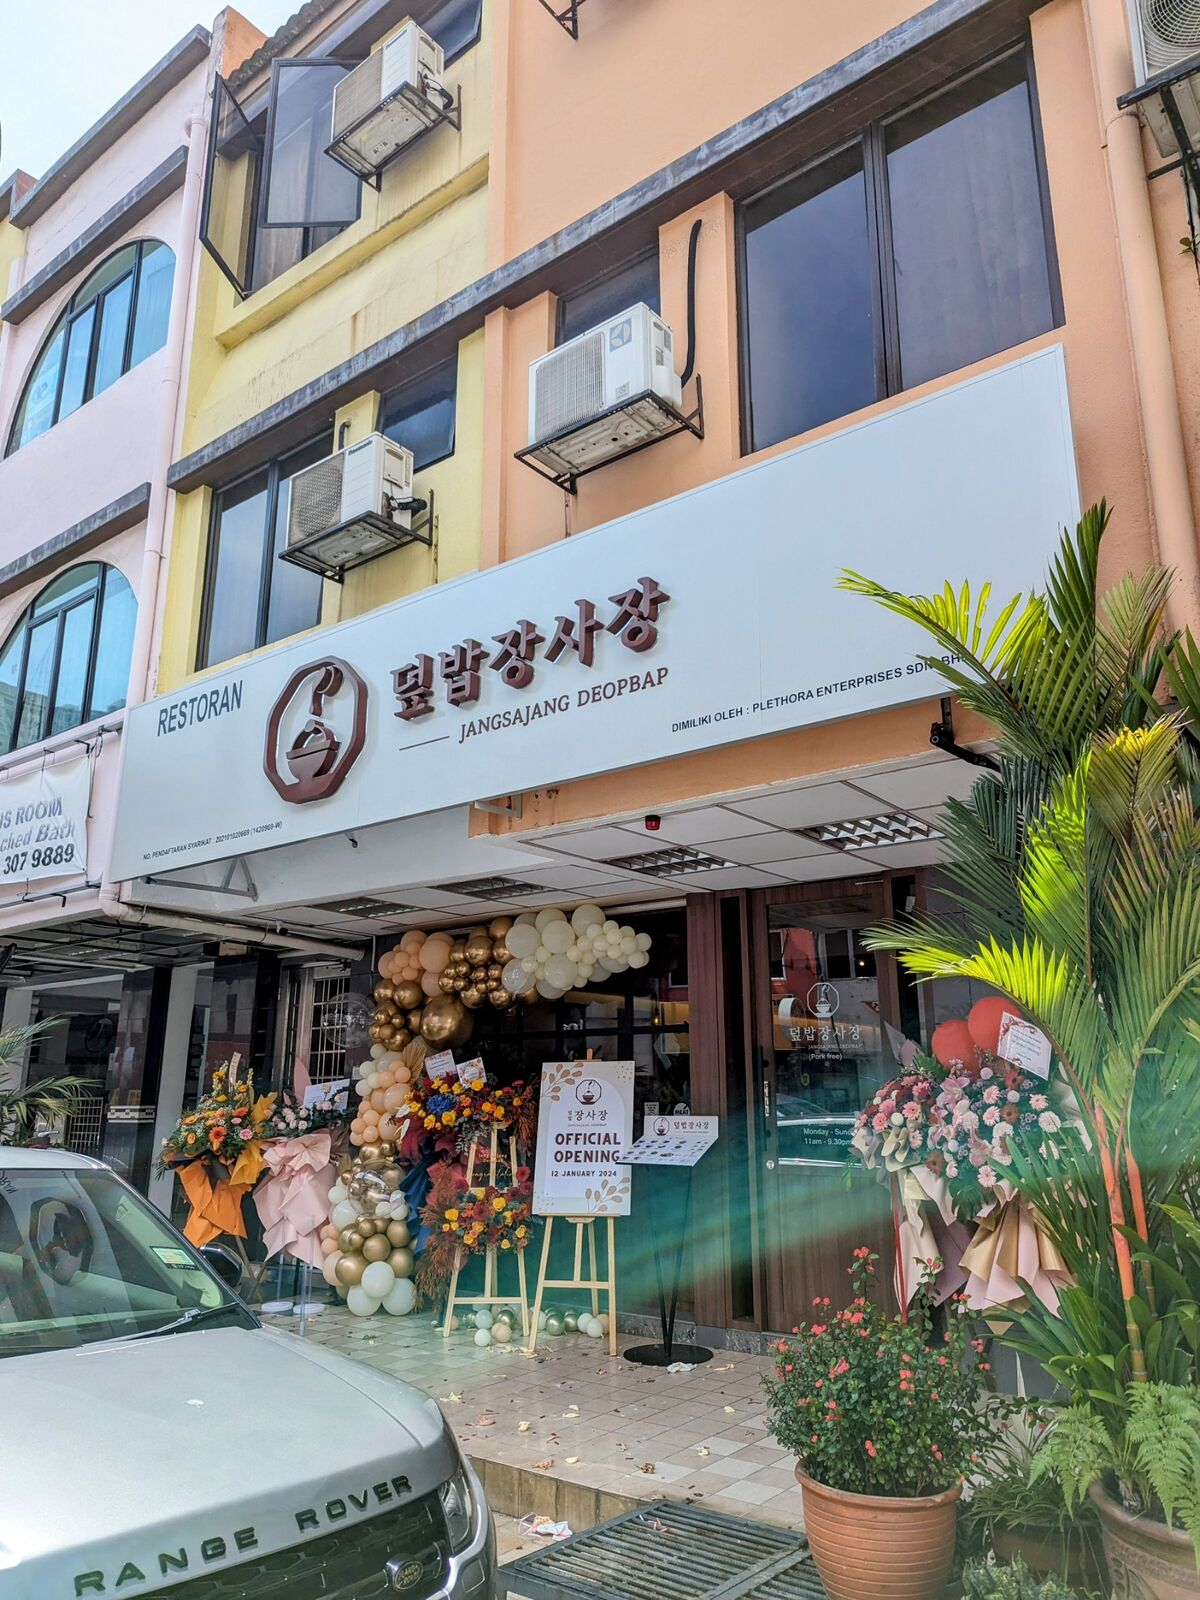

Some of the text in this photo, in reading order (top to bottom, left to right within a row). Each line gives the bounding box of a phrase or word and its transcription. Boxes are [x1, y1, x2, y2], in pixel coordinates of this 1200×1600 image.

[390, 576, 671, 721] 덮밥장사장
[157, 680, 243, 736] RESTORAN
[459, 667, 669, 743] JANGSAJANG DEOPBAP
[672, 715, 711, 732] DIMILIKI
[714, 707, 743, 722] OLEH
[752, 690, 814, 713] PLETHORA
[816, 668, 903, 698] ENTERPRISES
[941, 654, 961, 666] BH
[15, 797, 62, 825] ROOM
[3, 843, 75, 875] 307 9889
[789, 1025, 862, 1041] 덮밥장사장
[555, 1132, 621, 1145] OFFICIAL
[803, 1128, 829, 1136] Monday
[554, 1150, 620, 1163] OPENING
[74, 1475, 413, 1597] RANGE ROVER
